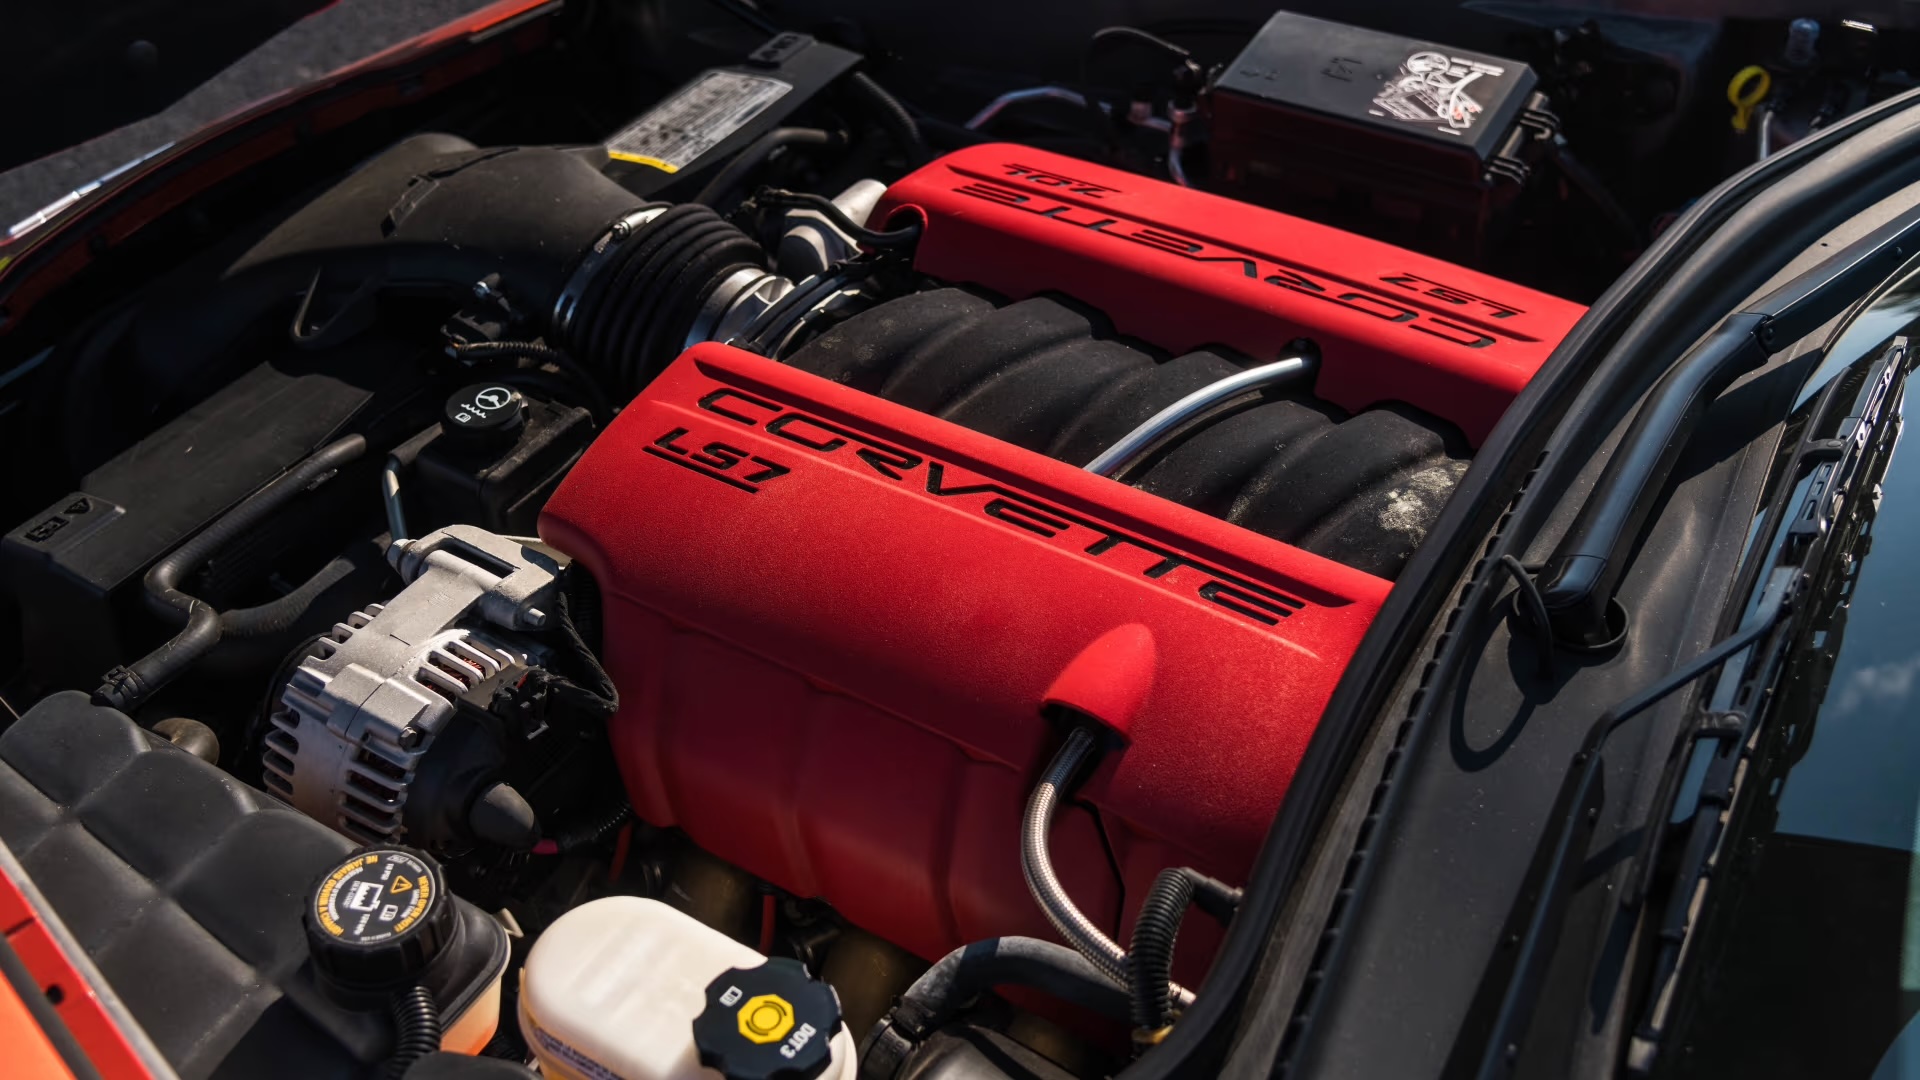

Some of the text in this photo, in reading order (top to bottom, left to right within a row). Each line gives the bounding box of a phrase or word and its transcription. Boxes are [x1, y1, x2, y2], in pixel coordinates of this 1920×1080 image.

[1002, 164, 1106, 199] 7.0L
[952, 183, 1497, 349] CORVETTE
[1379, 275, 1519, 319] LS7
[650, 427, 791, 487] LS7
[697, 387, 1306, 626] CORVETTE
[418, 875, 429, 898] NEVER
[410, 899, 427, 919] OPEN
[780, 1023, 817, 1059] DOT 3
